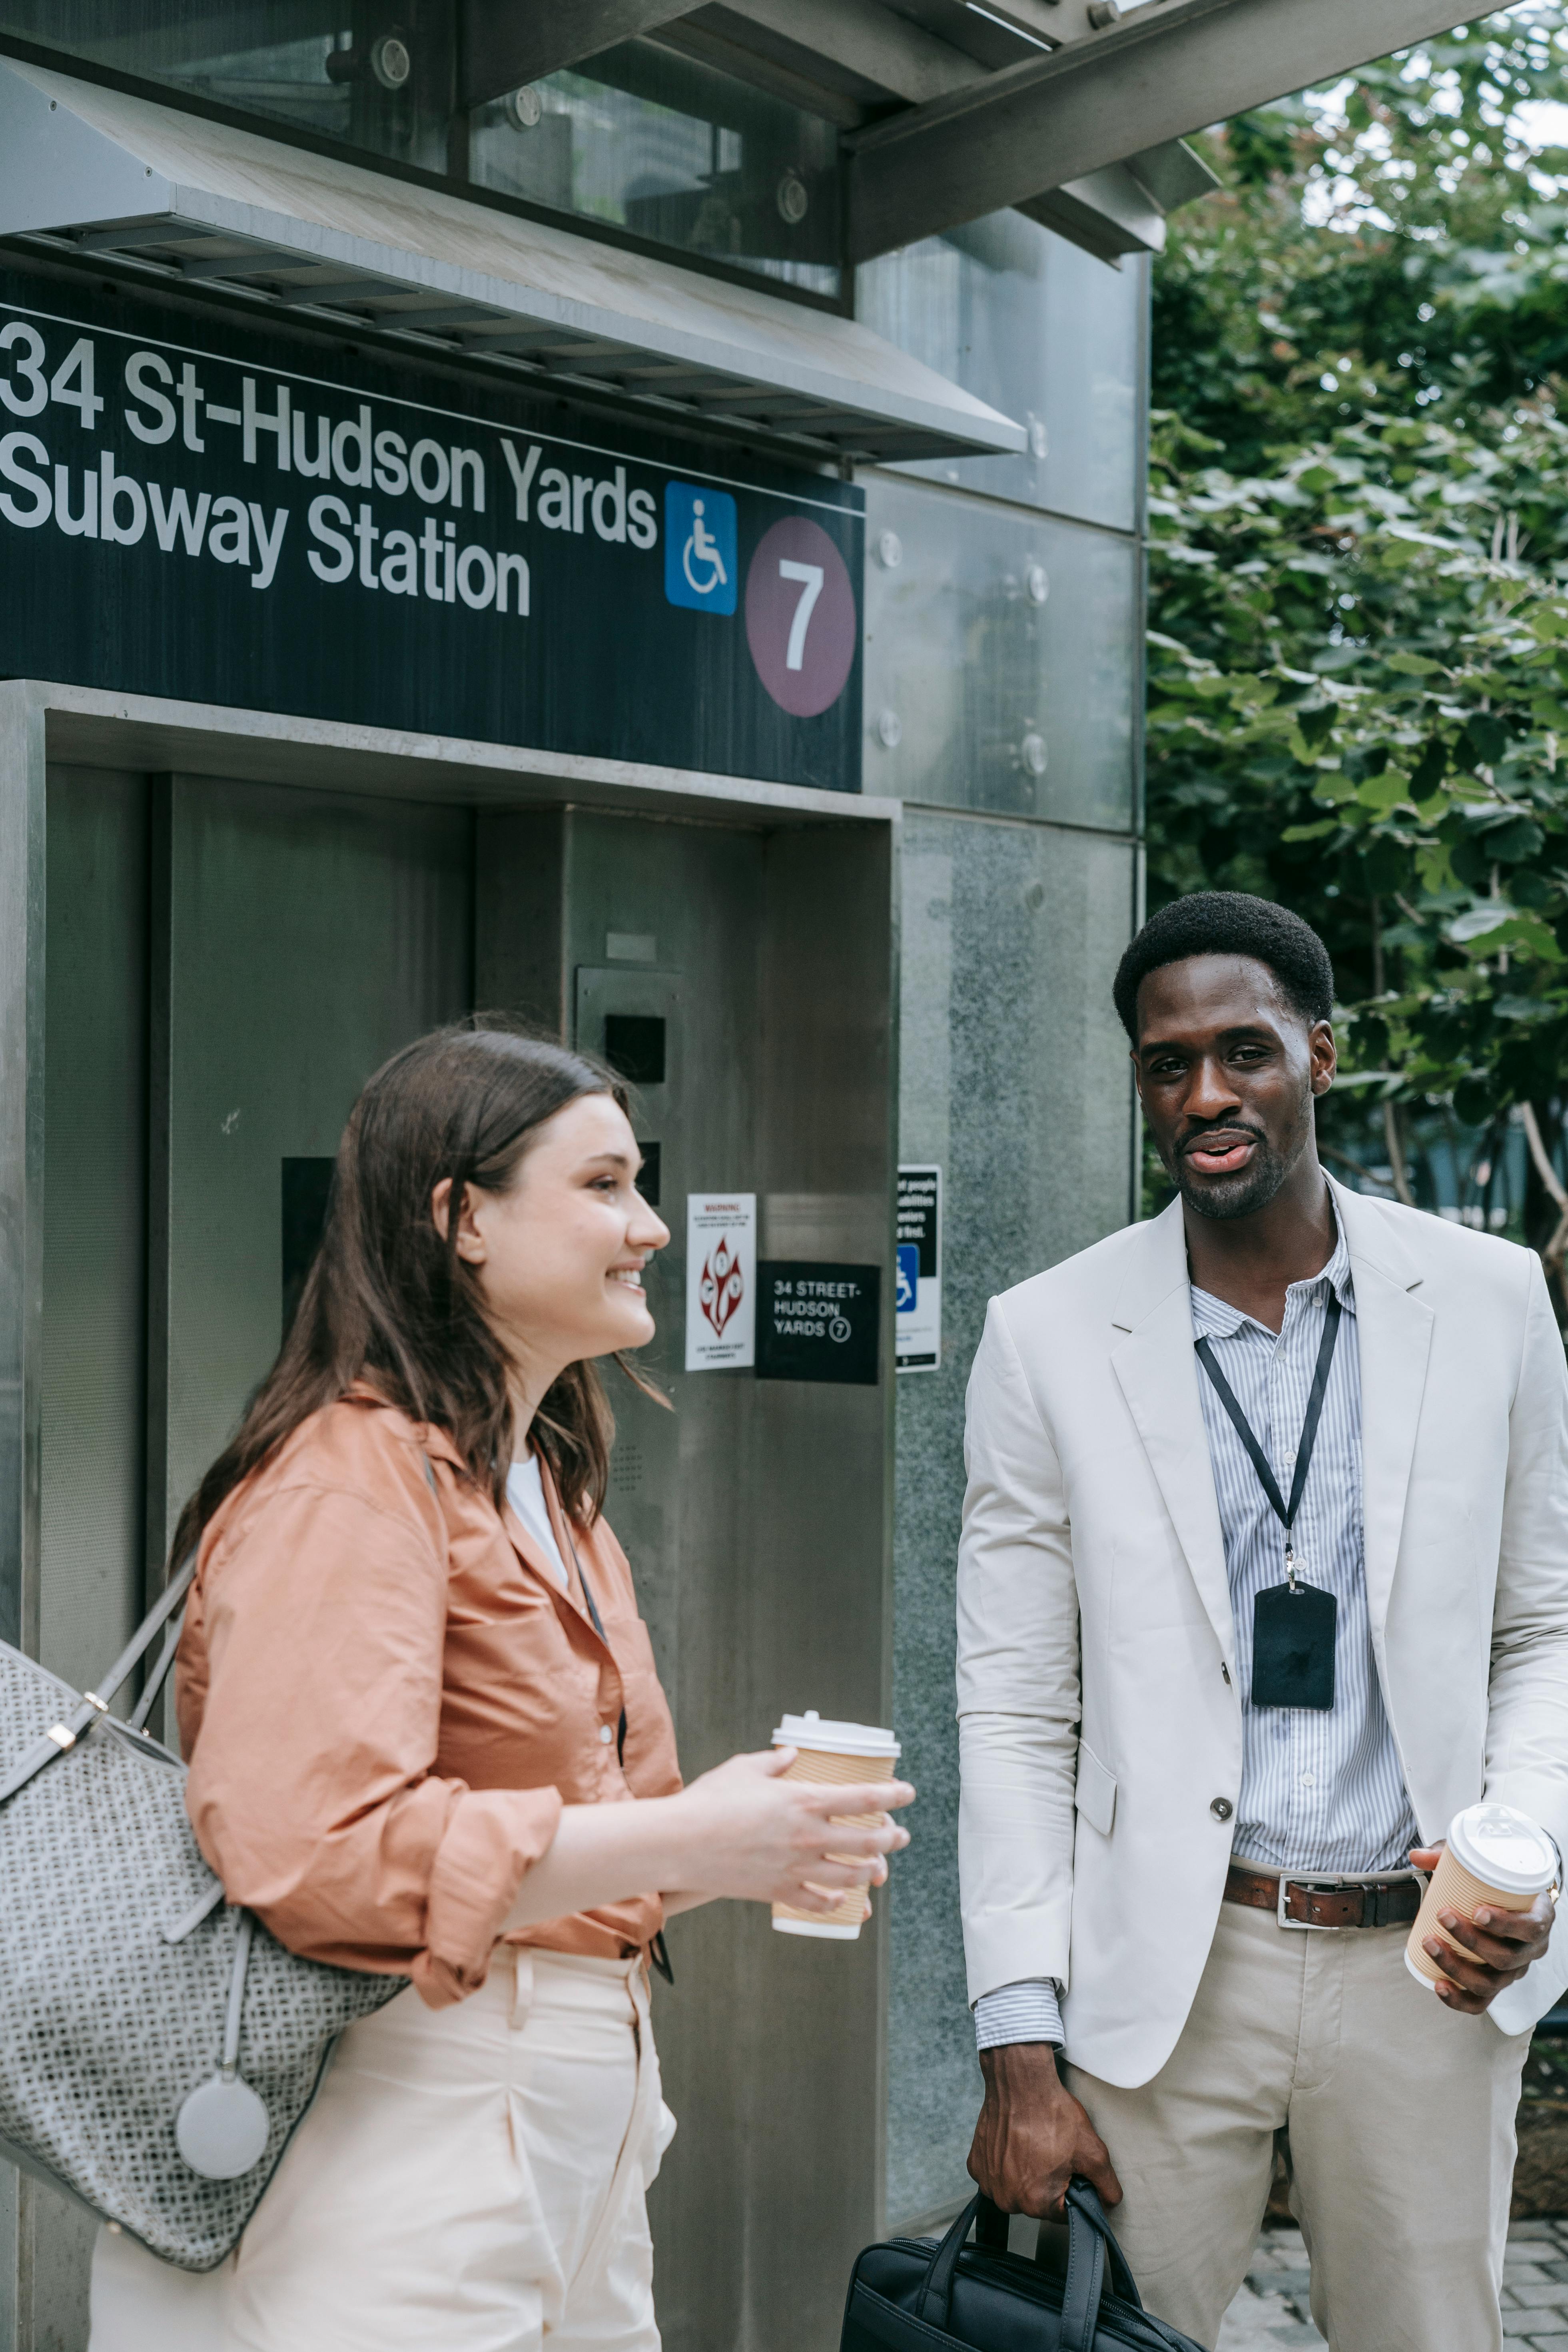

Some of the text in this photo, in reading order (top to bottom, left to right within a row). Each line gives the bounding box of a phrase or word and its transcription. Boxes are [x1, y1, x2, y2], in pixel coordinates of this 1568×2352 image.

[0, 321, 104, 430] 34
[501, 438, 657, 549] Yards
[0, 431, 530, 616] Subway Station
[778, 558, 825, 673] 7
[774, 1280, 861, 1298] 34 STREET-
[774, 1300, 840, 1317] HUDSON
[774, 1319, 845, 1337] YARDS 7
